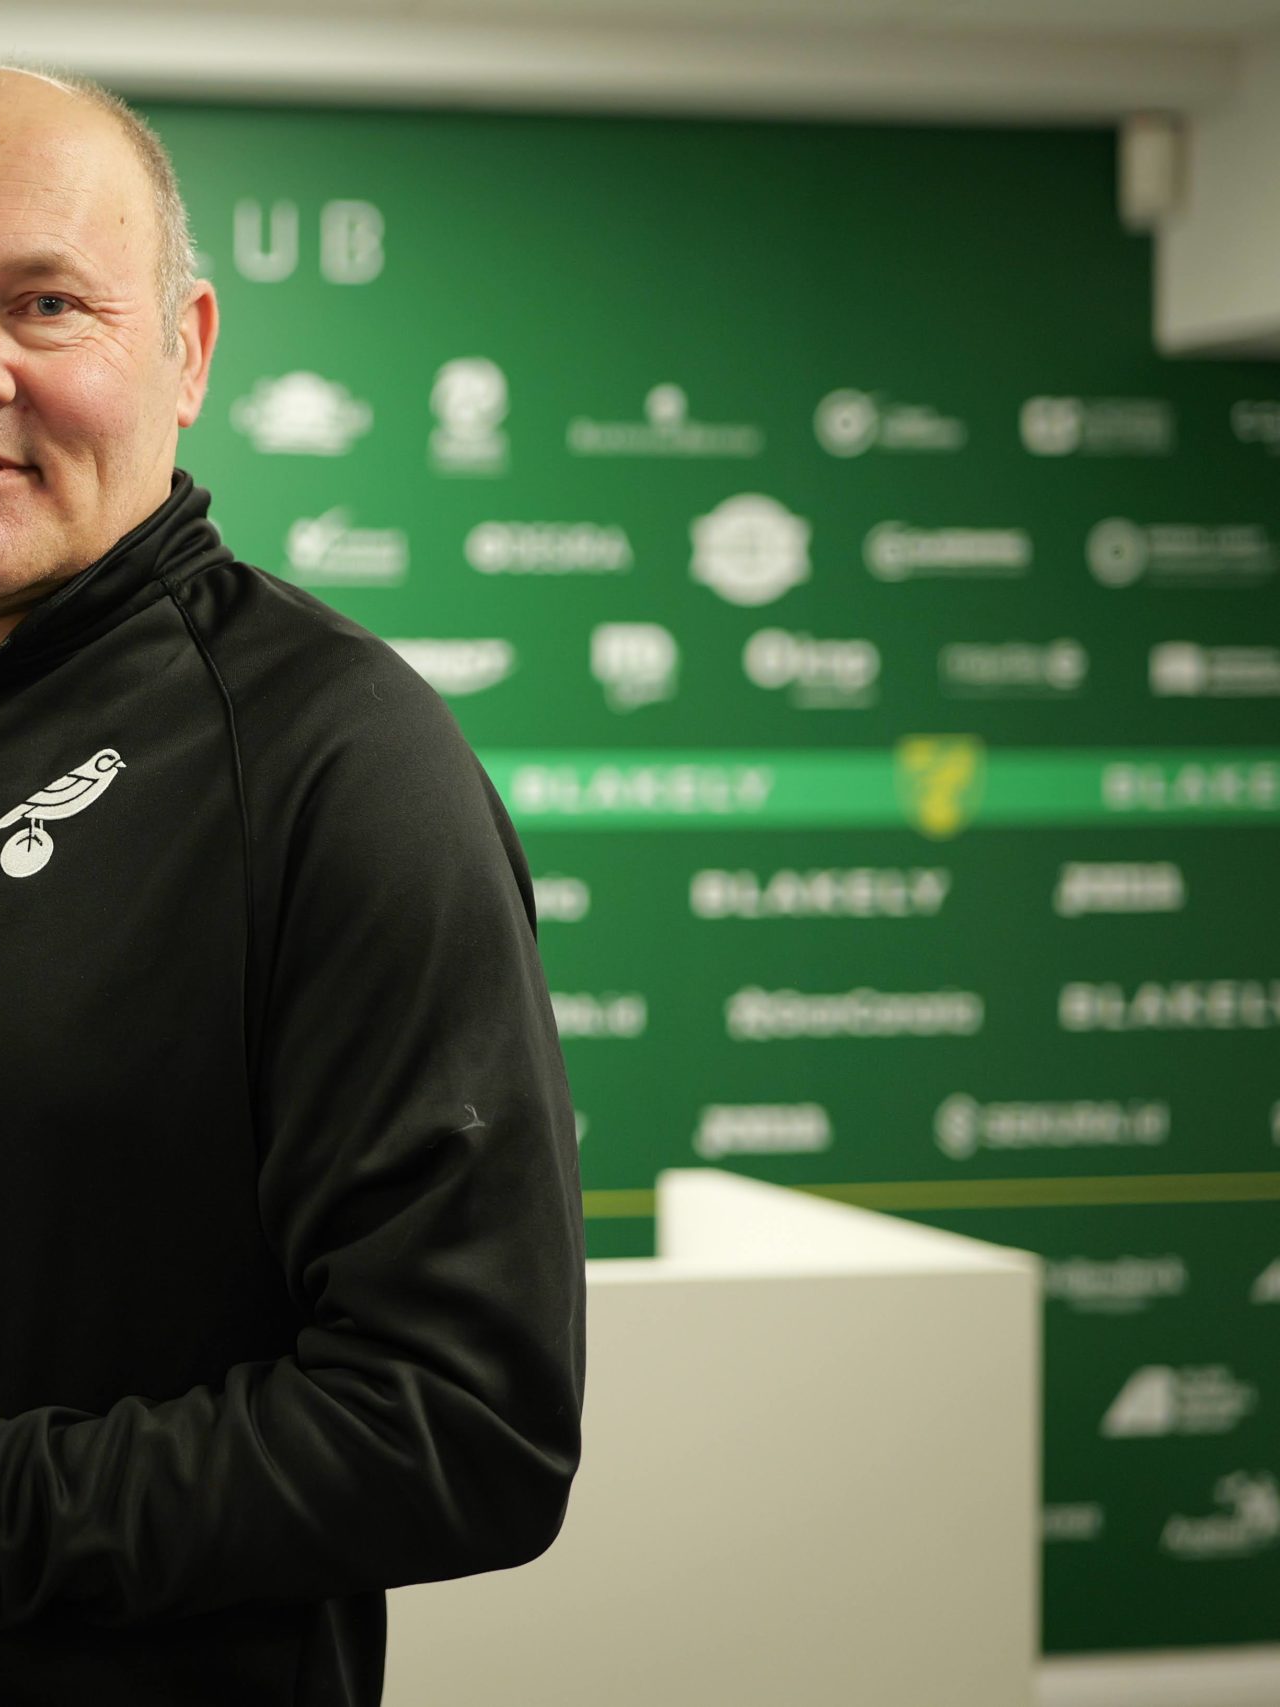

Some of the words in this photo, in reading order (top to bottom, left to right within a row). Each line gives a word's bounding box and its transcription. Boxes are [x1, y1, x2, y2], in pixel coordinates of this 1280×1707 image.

[192, 198, 385, 285] UB
[511, 764, 775, 814] BLAKELY
[690, 866, 952, 919] BLAKELY
